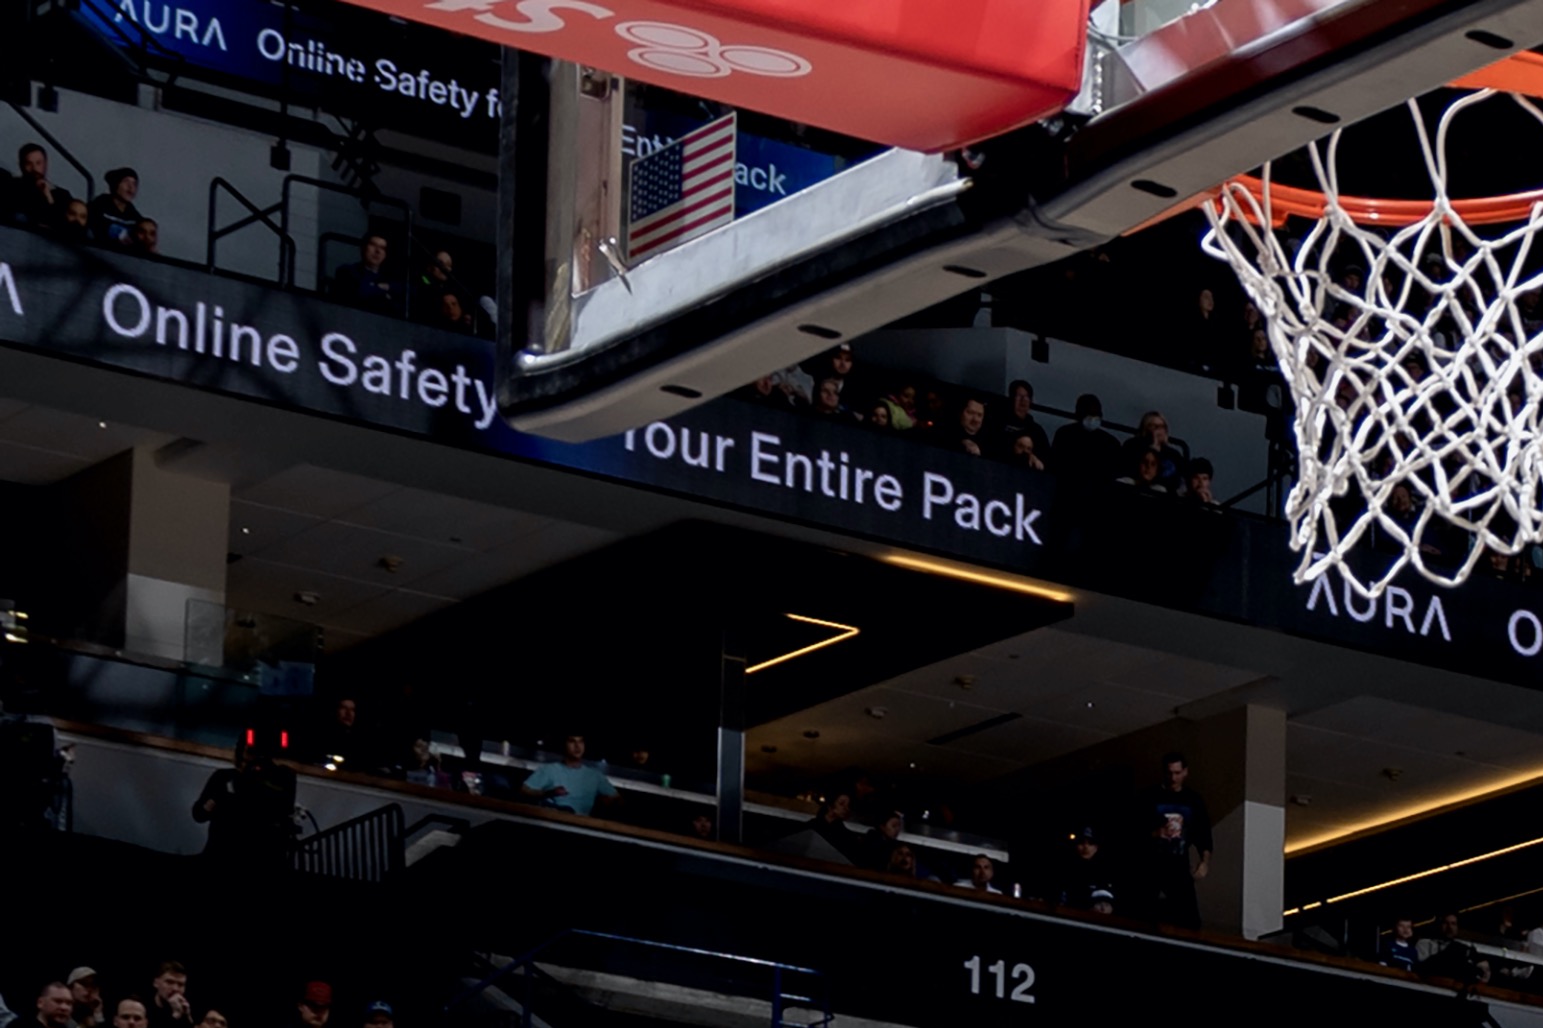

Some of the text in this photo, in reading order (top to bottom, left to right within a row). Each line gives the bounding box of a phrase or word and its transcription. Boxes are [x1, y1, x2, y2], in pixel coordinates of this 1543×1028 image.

[256, 27, 367, 84] Online
[373, 59, 480, 119] Safety
[734, 161, 787, 195] ack
[101, 281, 301, 374] Online
[316, 330, 498, 431] Safety
[749, 429, 904, 512] Entire
[921, 470, 1045, 547] Pack
[962, 953, 1037, 1006] 112
